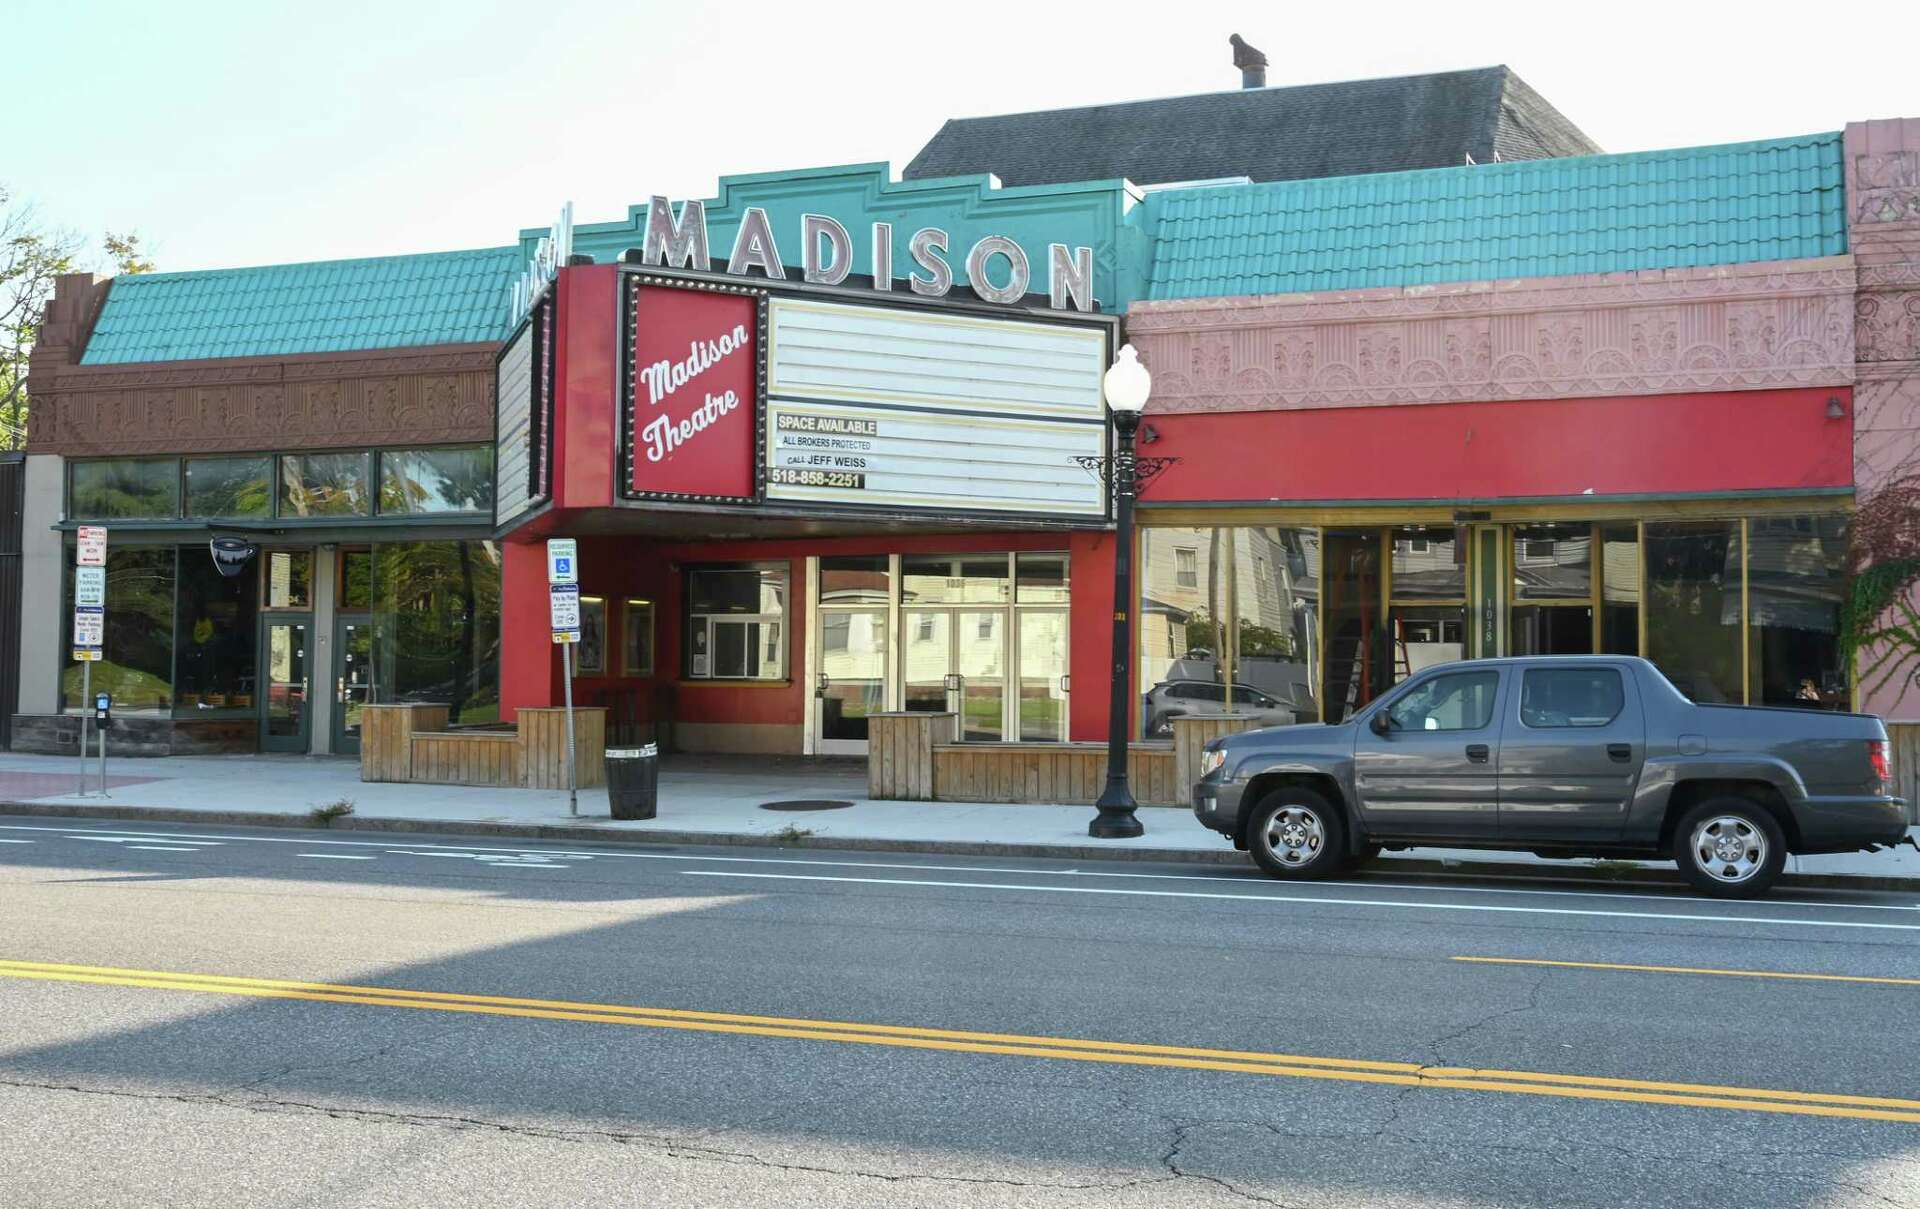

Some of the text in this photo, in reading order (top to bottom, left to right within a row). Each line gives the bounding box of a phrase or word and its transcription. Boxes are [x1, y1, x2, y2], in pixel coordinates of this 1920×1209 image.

[642, 195, 1093, 313] MADISON
[640, 324, 749, 405] Madison
[642, 389, 740, 462] Theatre
[778, 415, 876, 434] SPACE AVAILABLE
[783, 436, 871, 450] ALL BROKERS PROTECTED
[787, 454, 866, 468] CALL JEFF WEISS
[772, 469, 859, 487] 518-858-2251
